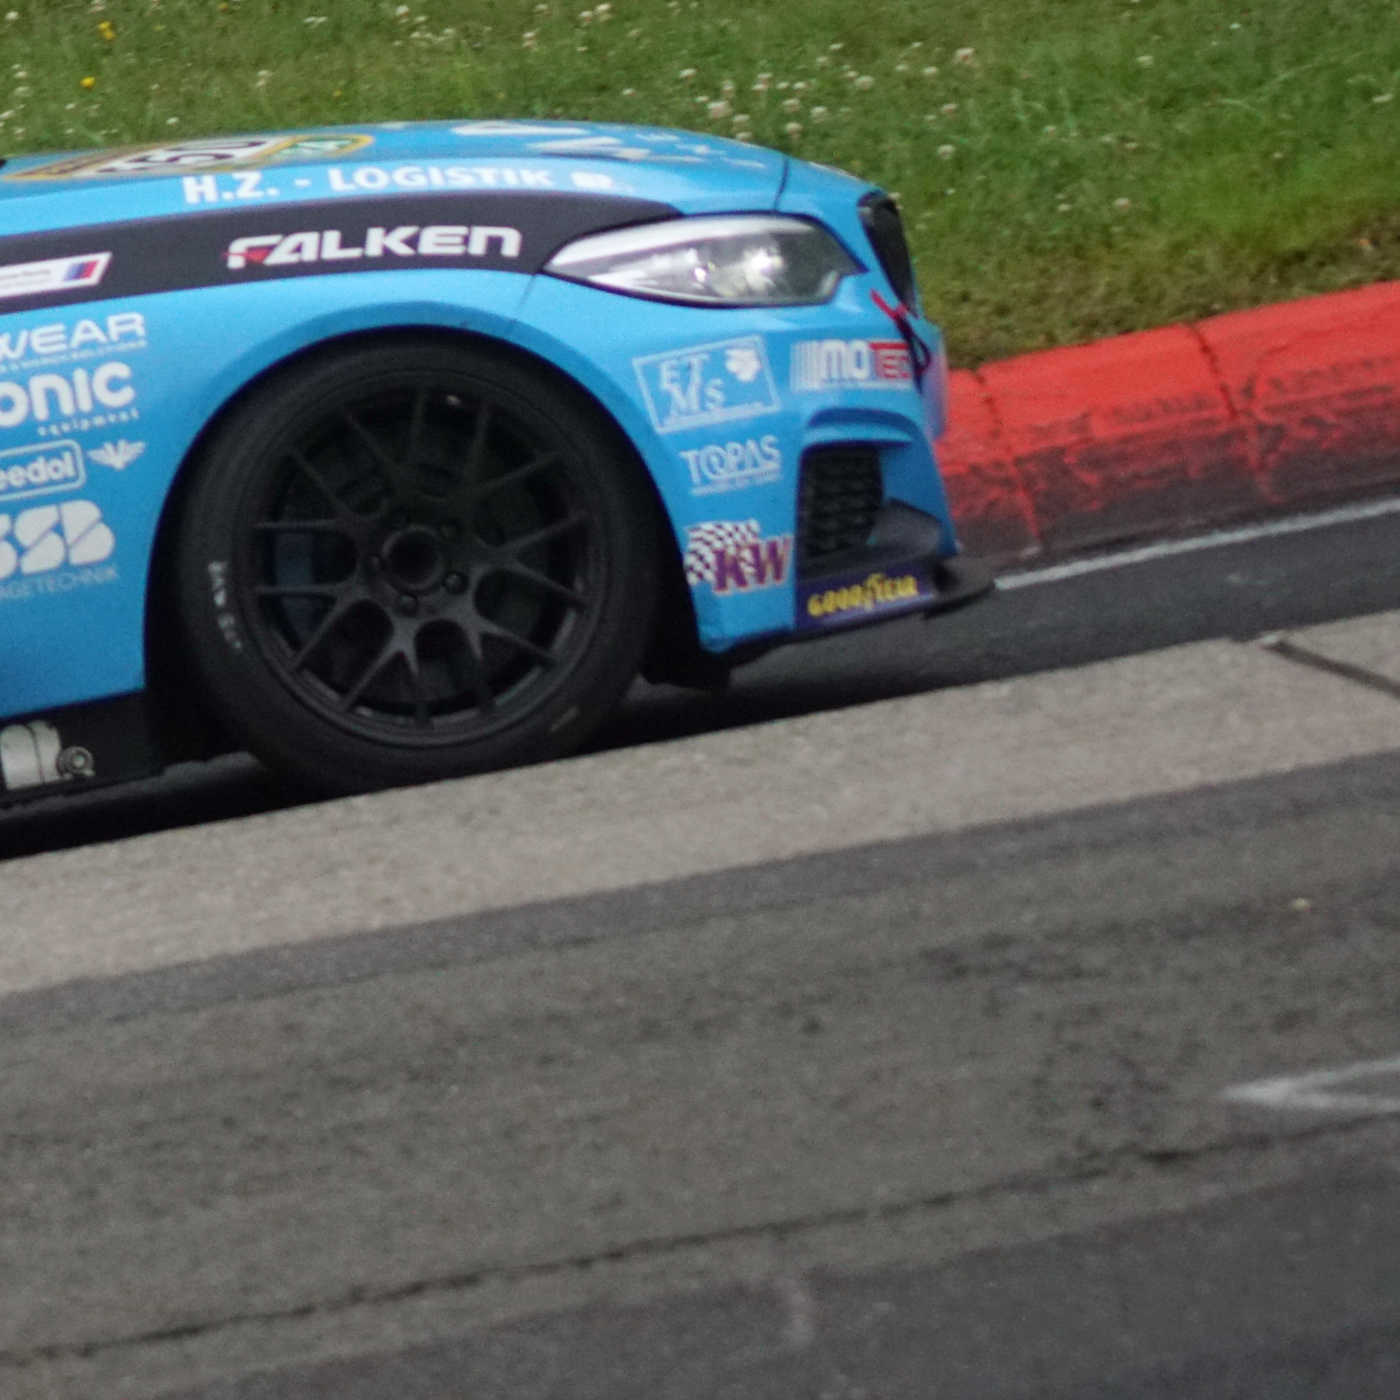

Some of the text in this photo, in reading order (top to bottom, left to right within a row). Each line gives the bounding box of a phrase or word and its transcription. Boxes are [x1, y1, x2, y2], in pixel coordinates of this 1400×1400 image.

[182, 171, 280, 204] H.Z.
[328, 165, 554, 193] LOGISTIK
[224, 224, 522, 270] FALKEN
[679, 433, 782, 484] TOPAS
